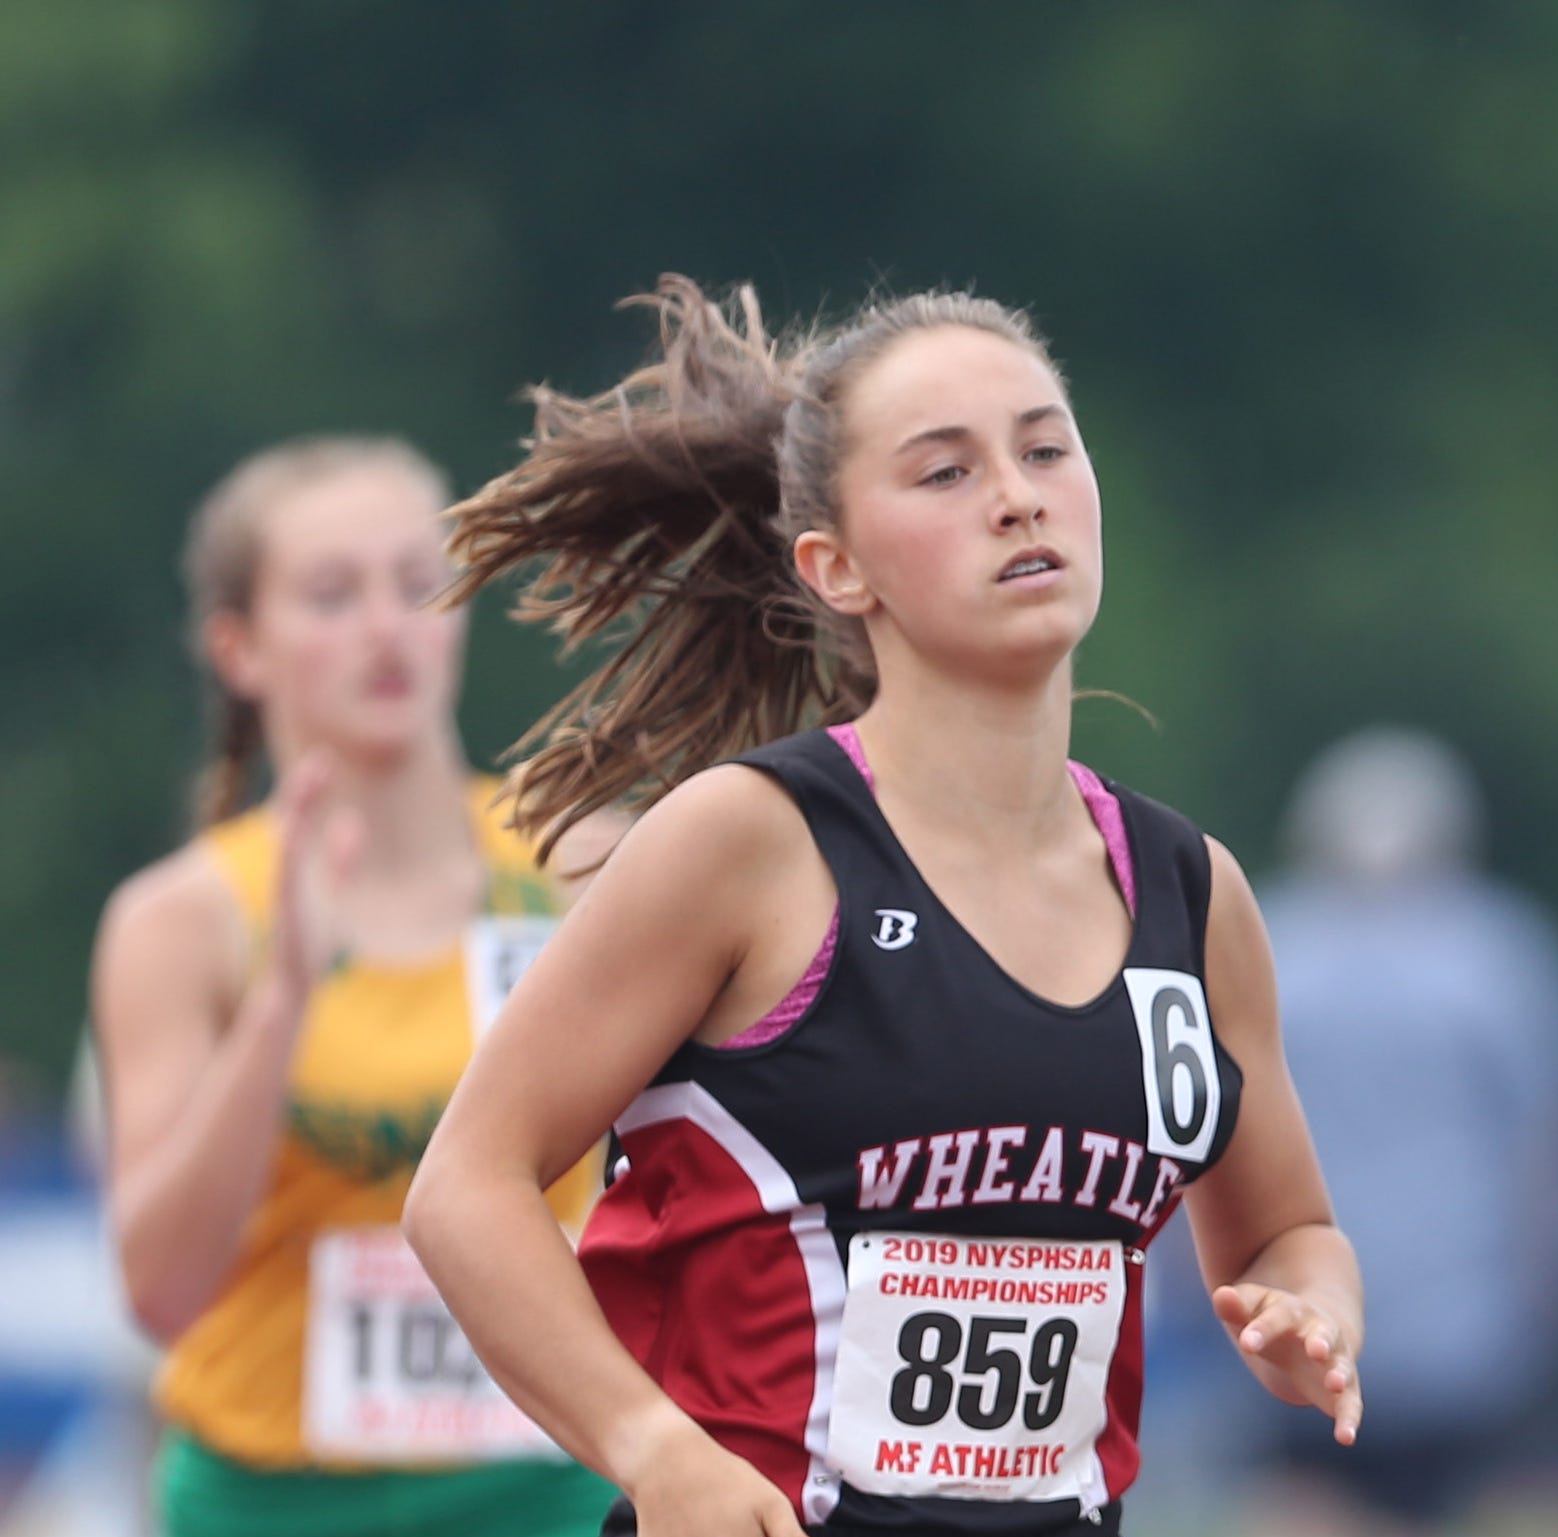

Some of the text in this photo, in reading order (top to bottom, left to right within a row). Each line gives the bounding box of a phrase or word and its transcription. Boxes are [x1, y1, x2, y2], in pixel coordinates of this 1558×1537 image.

[1149, 987, 1208, 1147] 6
[883, 1238, 1112, 1271] 2019 NYSPHSAA
[880, 1273, 1107, 1304] CHAMPIONSHIPS
[889, 1312, 1079, 1431] 859
[930, 1443, 1066, 1478] ATHLETIC
